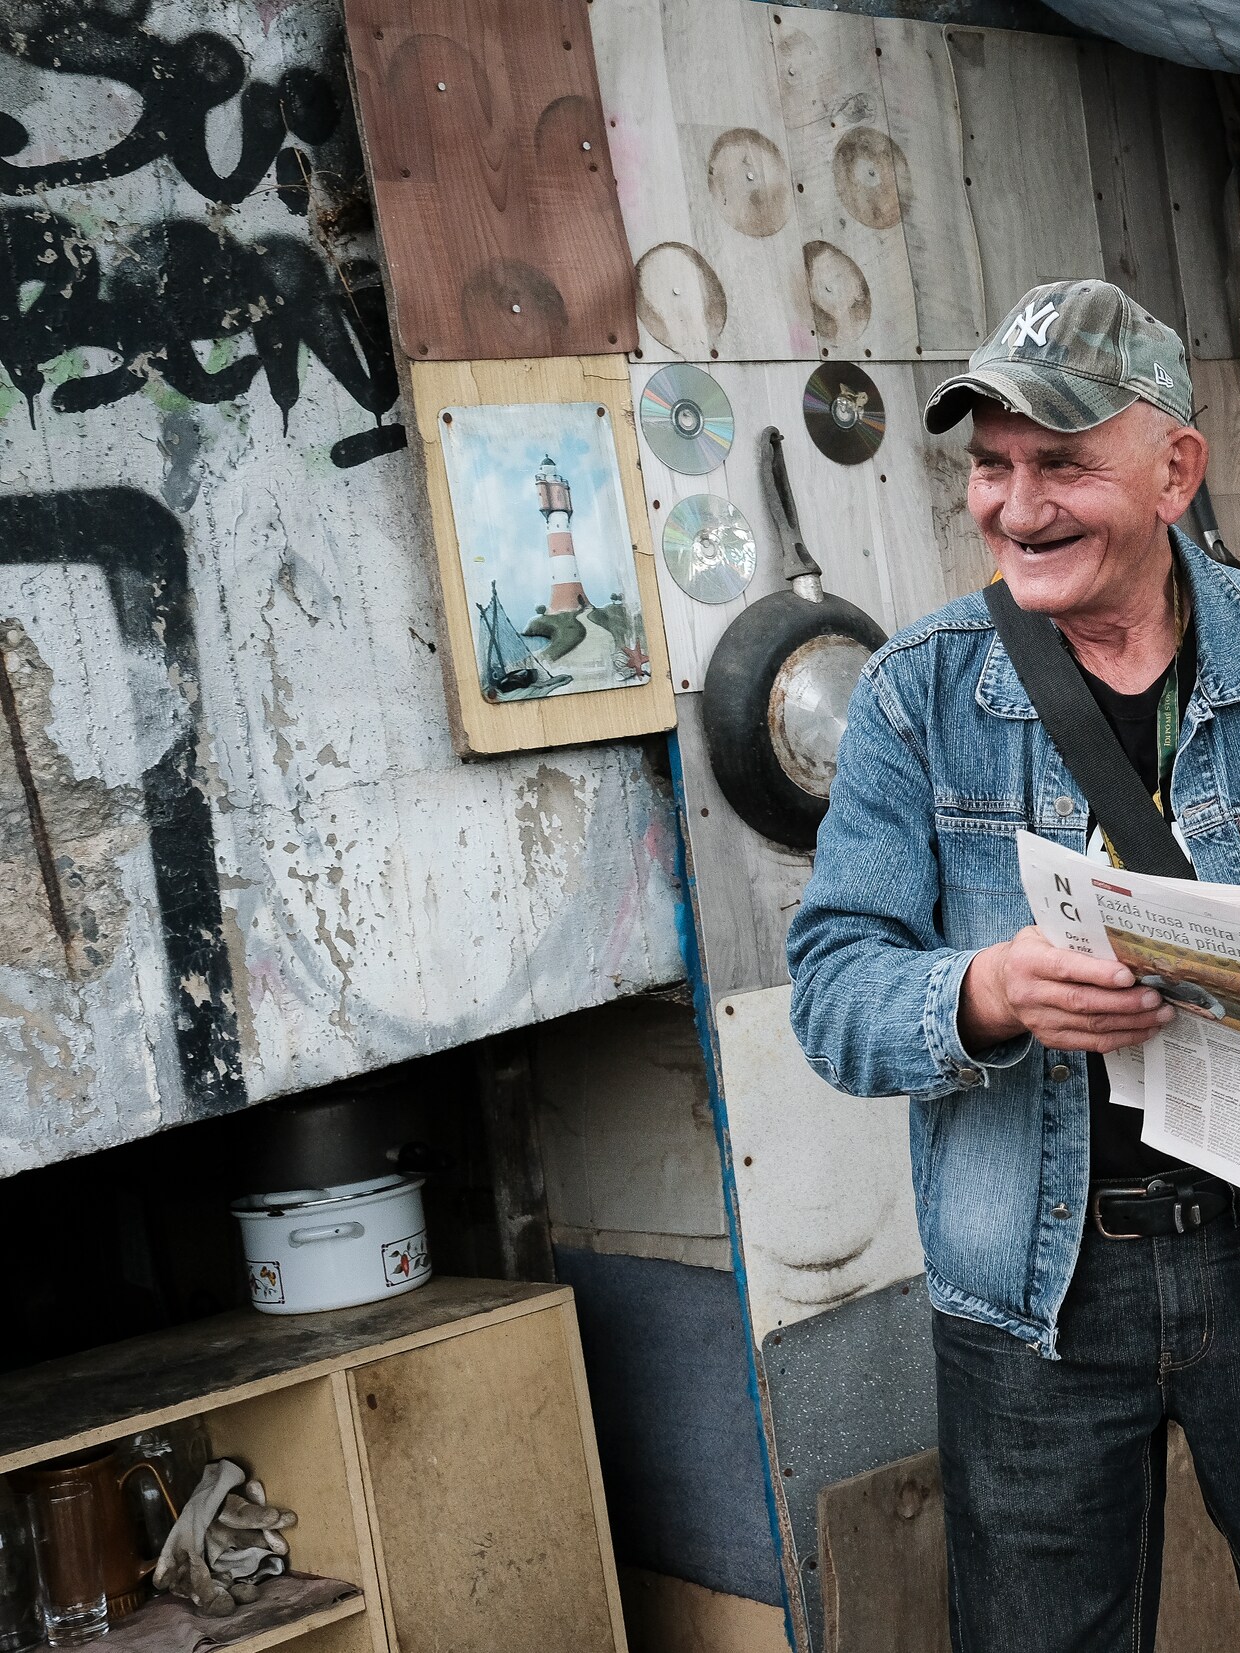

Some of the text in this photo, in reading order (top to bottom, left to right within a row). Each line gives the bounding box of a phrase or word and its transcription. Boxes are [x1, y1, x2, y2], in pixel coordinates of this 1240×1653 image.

[1095, 893, 1141, 918] Každá
[1145, 909, 1184, 929] trasa
[1188, 921, 1234, 941] metra
[1118, 916, 1134, 930] to
[1136, 923, 1191, 946] vysoká
